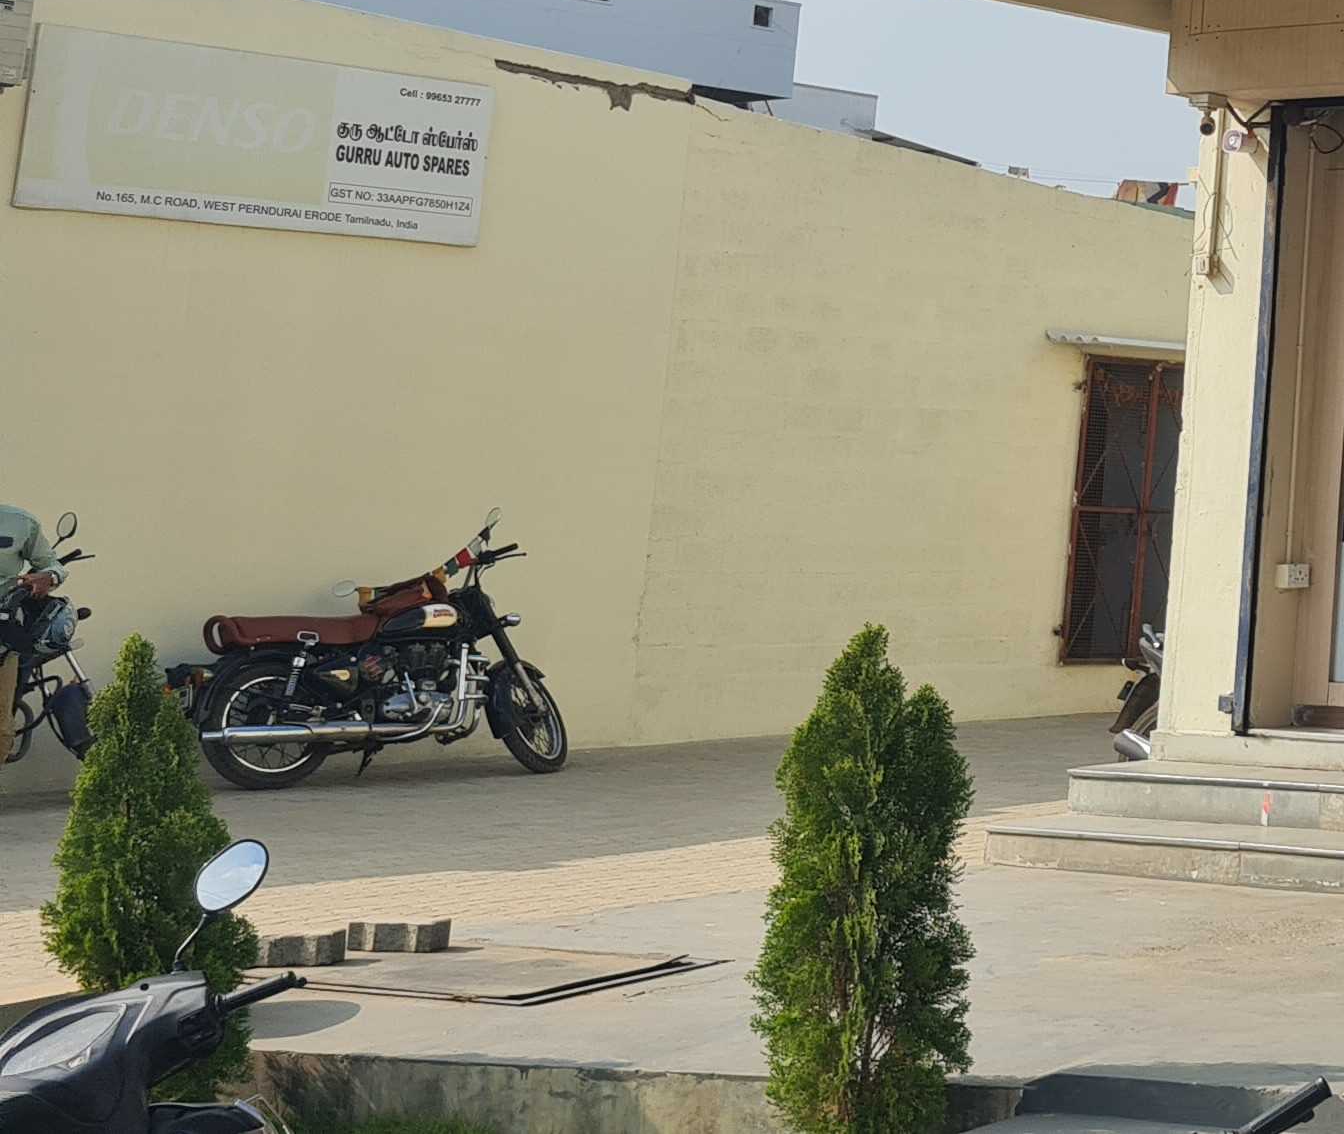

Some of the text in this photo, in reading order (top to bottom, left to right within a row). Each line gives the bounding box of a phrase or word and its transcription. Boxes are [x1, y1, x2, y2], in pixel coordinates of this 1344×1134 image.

[400, 88, 418, 98] Cell
[105, 88, 317, 153] DENSO
[336, 122, 363, 141] குரு
[335, 144, 470, 177] GURRU AUTO SPARES
[330, 187, 352, 200] GST
[355, 191, 375, 202] NO:
[96, 191, 418, 230] No.165, M.C ROAD, WEST PERNDURAI ERODE Tamilnadu, India
